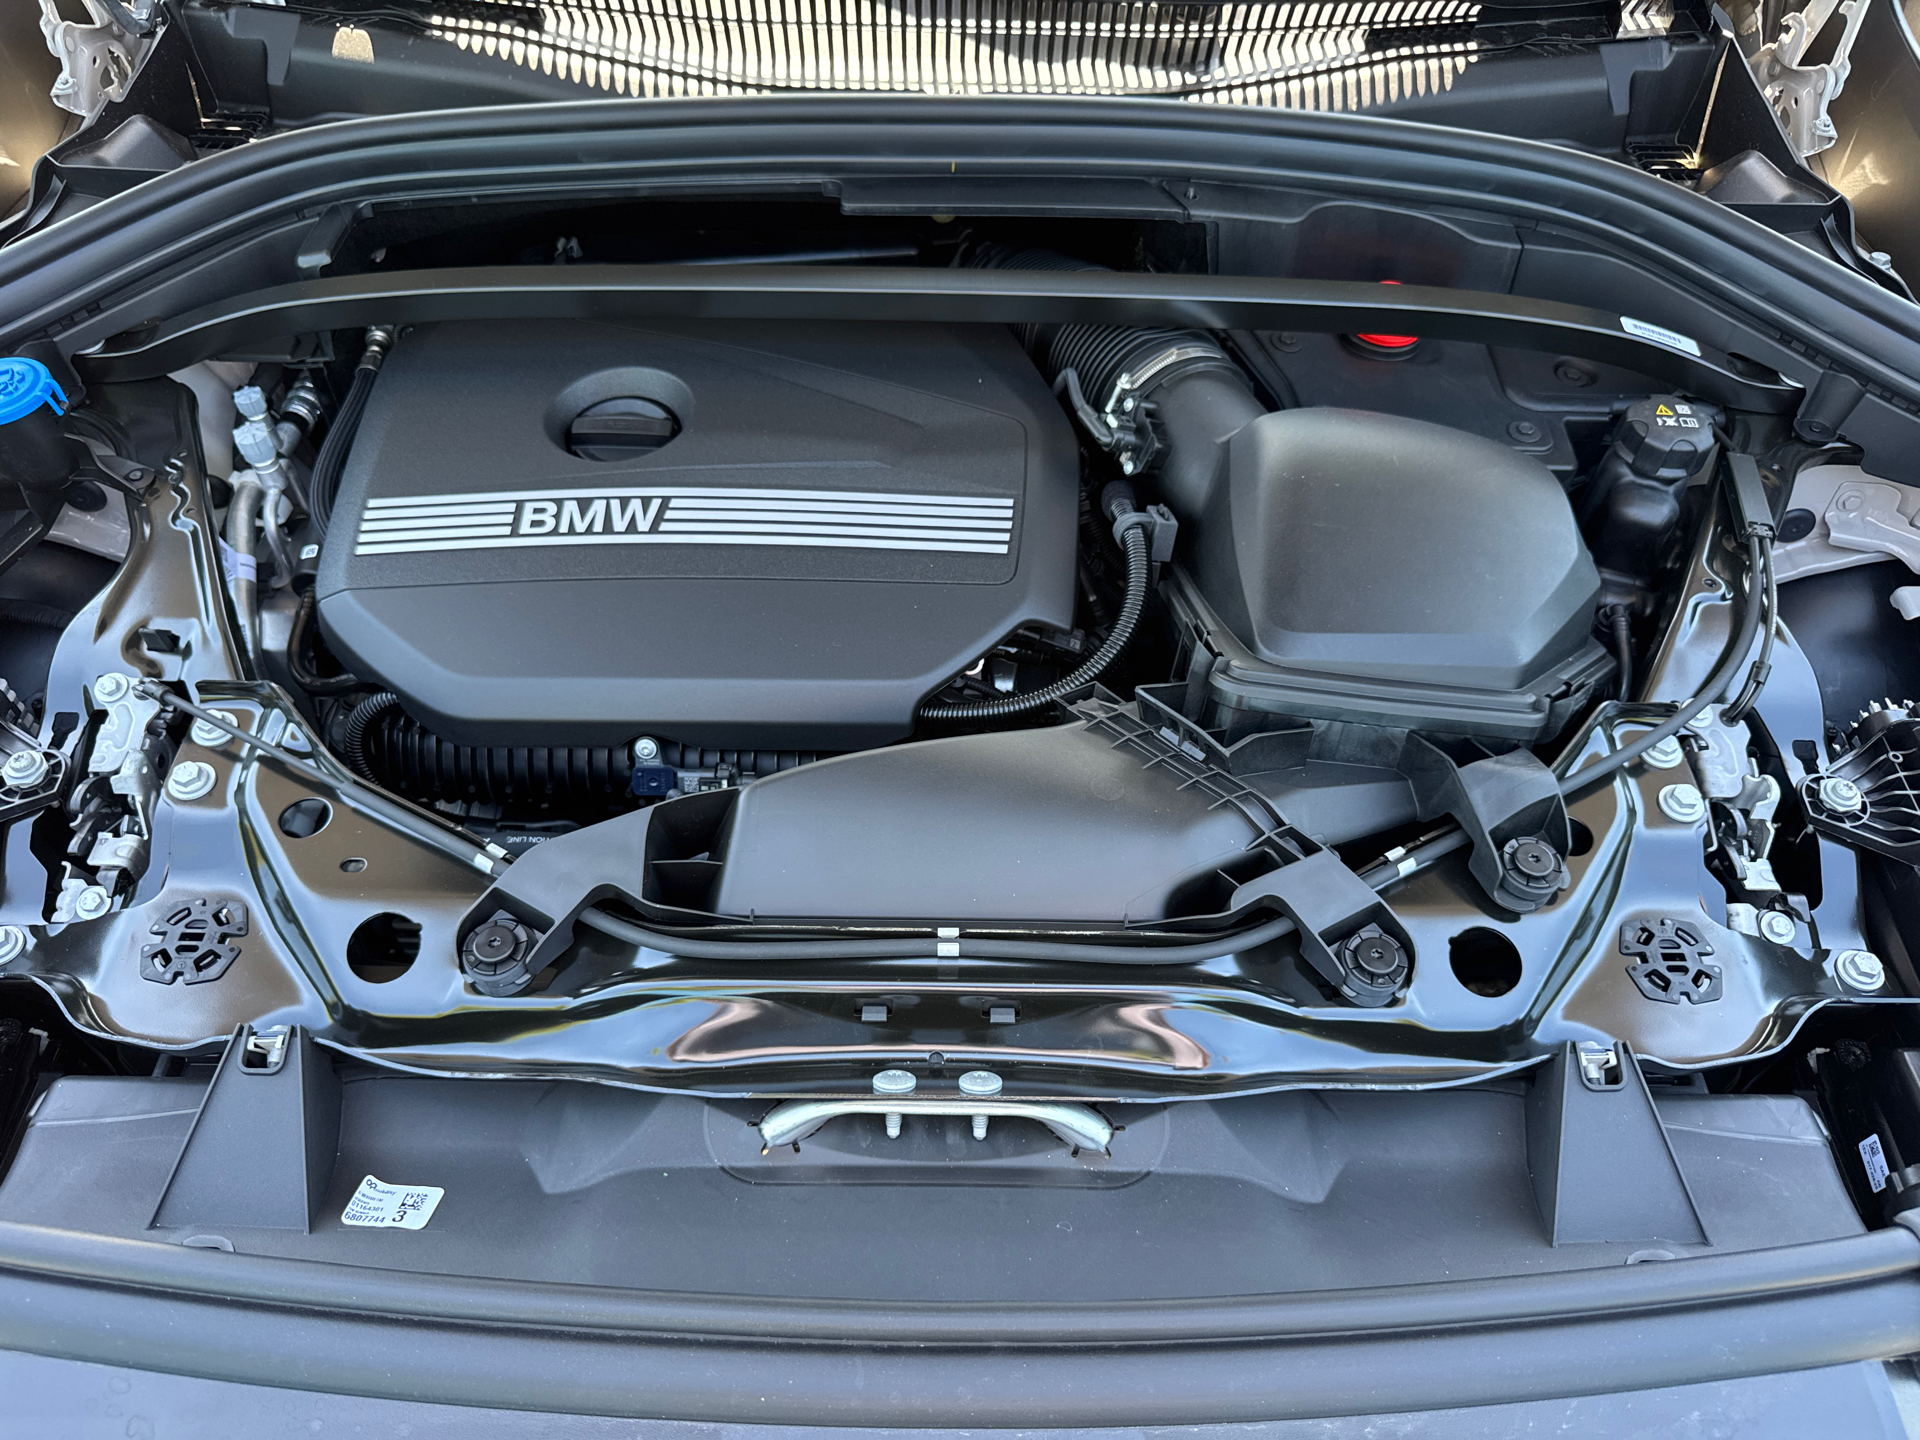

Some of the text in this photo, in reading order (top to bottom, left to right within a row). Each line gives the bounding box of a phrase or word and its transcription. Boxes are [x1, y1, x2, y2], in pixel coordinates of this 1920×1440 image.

[518, 498, 662, 534] BMW
[506, 836, 528, 844] LINE
[344, 1211, 385, 1223] 6807744
[392, 1210, 407, 1222] 3
